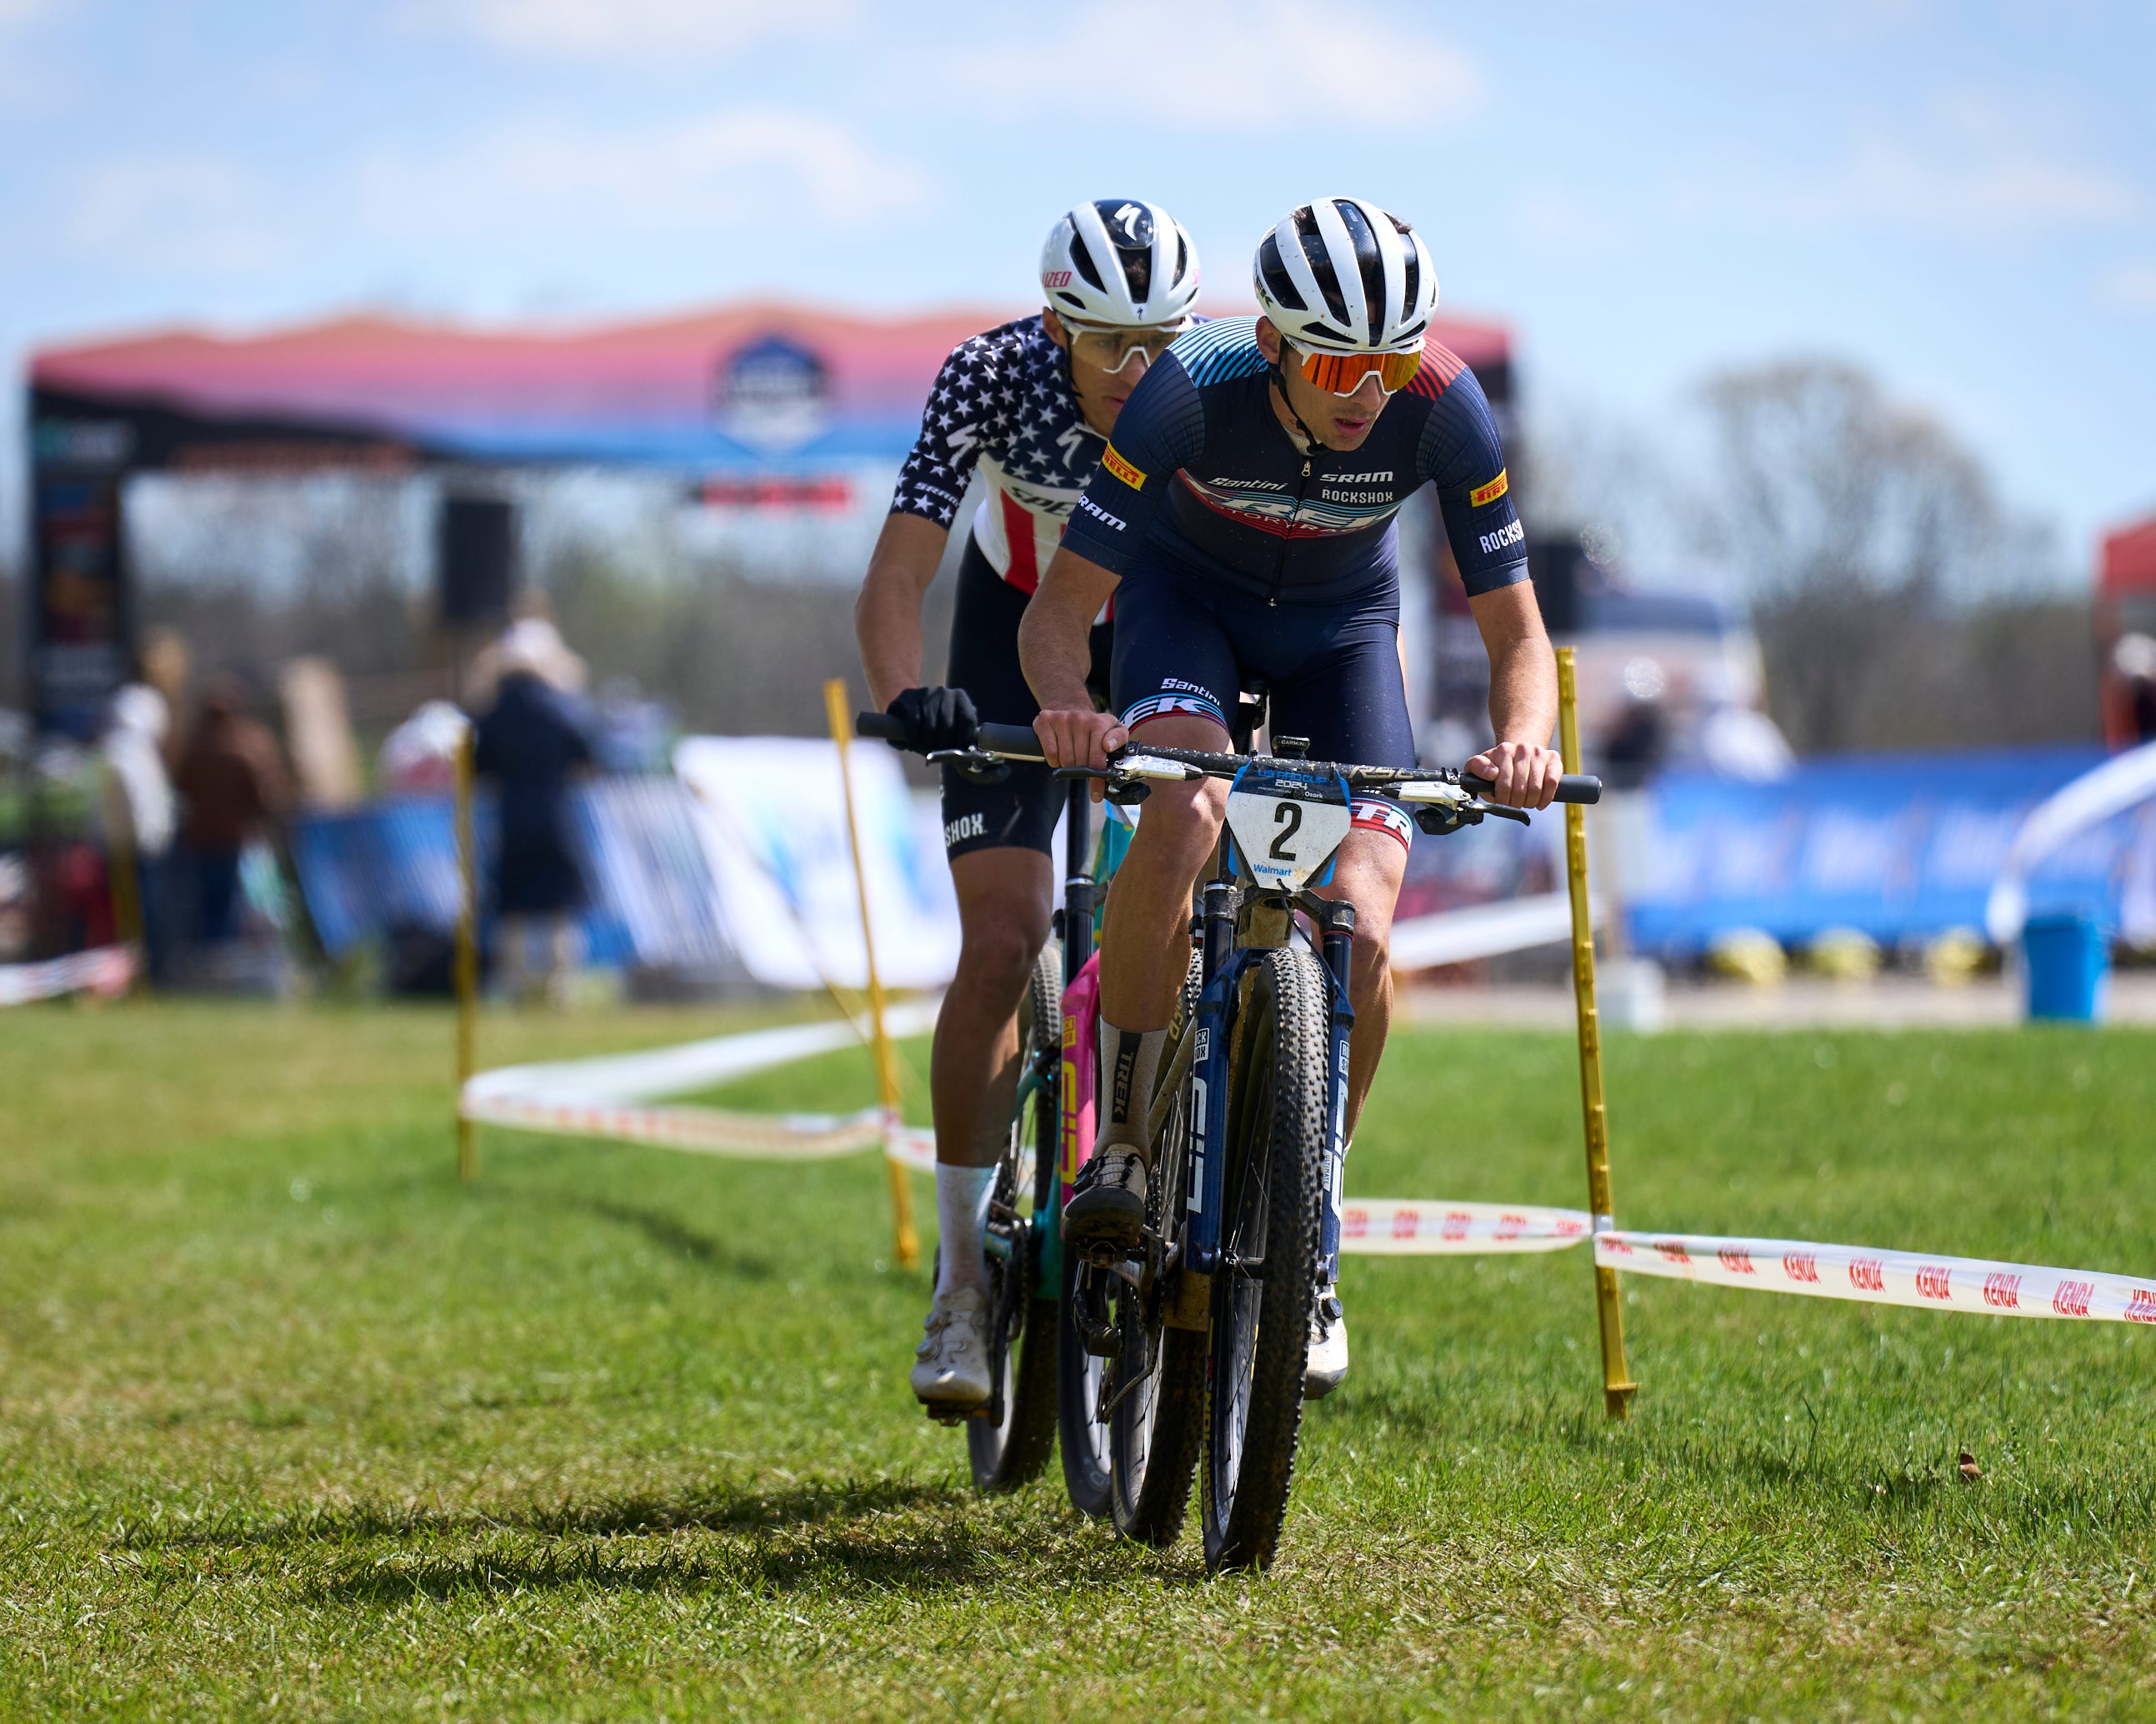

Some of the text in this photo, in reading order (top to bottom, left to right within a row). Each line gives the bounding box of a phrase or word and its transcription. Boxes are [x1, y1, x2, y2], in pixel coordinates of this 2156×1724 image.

[1208, 477, 1288, 492] Santini
[1319, 471, 1393, 483] SRAM
[1477, 476, 1508, 502] PIRE
[1011, 487, 1076, 517] SPE
[1078, 492, 1127, 532] RAM
[1321, 488, 1393, 504] ROCKSHOX
[1160, 677, 1221, 707] Santini
[1123, 697, 1206, 728] EK
[1258, 769, 1274, 778] US
[1274, 779, 1308, 790] 2024
[1268, 802, 1303, 862] 2
[1351, 802, 1413, 844] TR
[1253, 864, 1292, 877] Walmart
[1113, 1051, 1135, 1119] TREK
[1783, 1250, 1821, 1284] KENDA
[1848, 1256, 1886, 1292] KENDA
[1915, 1264, 1953, 1302] KENDA
[1983, 1272, 2022, 1309] KENDA
[2053, 1280, 2094, 1317] KENDA
[1202, 1391, 1213, 1515] SCORPION
